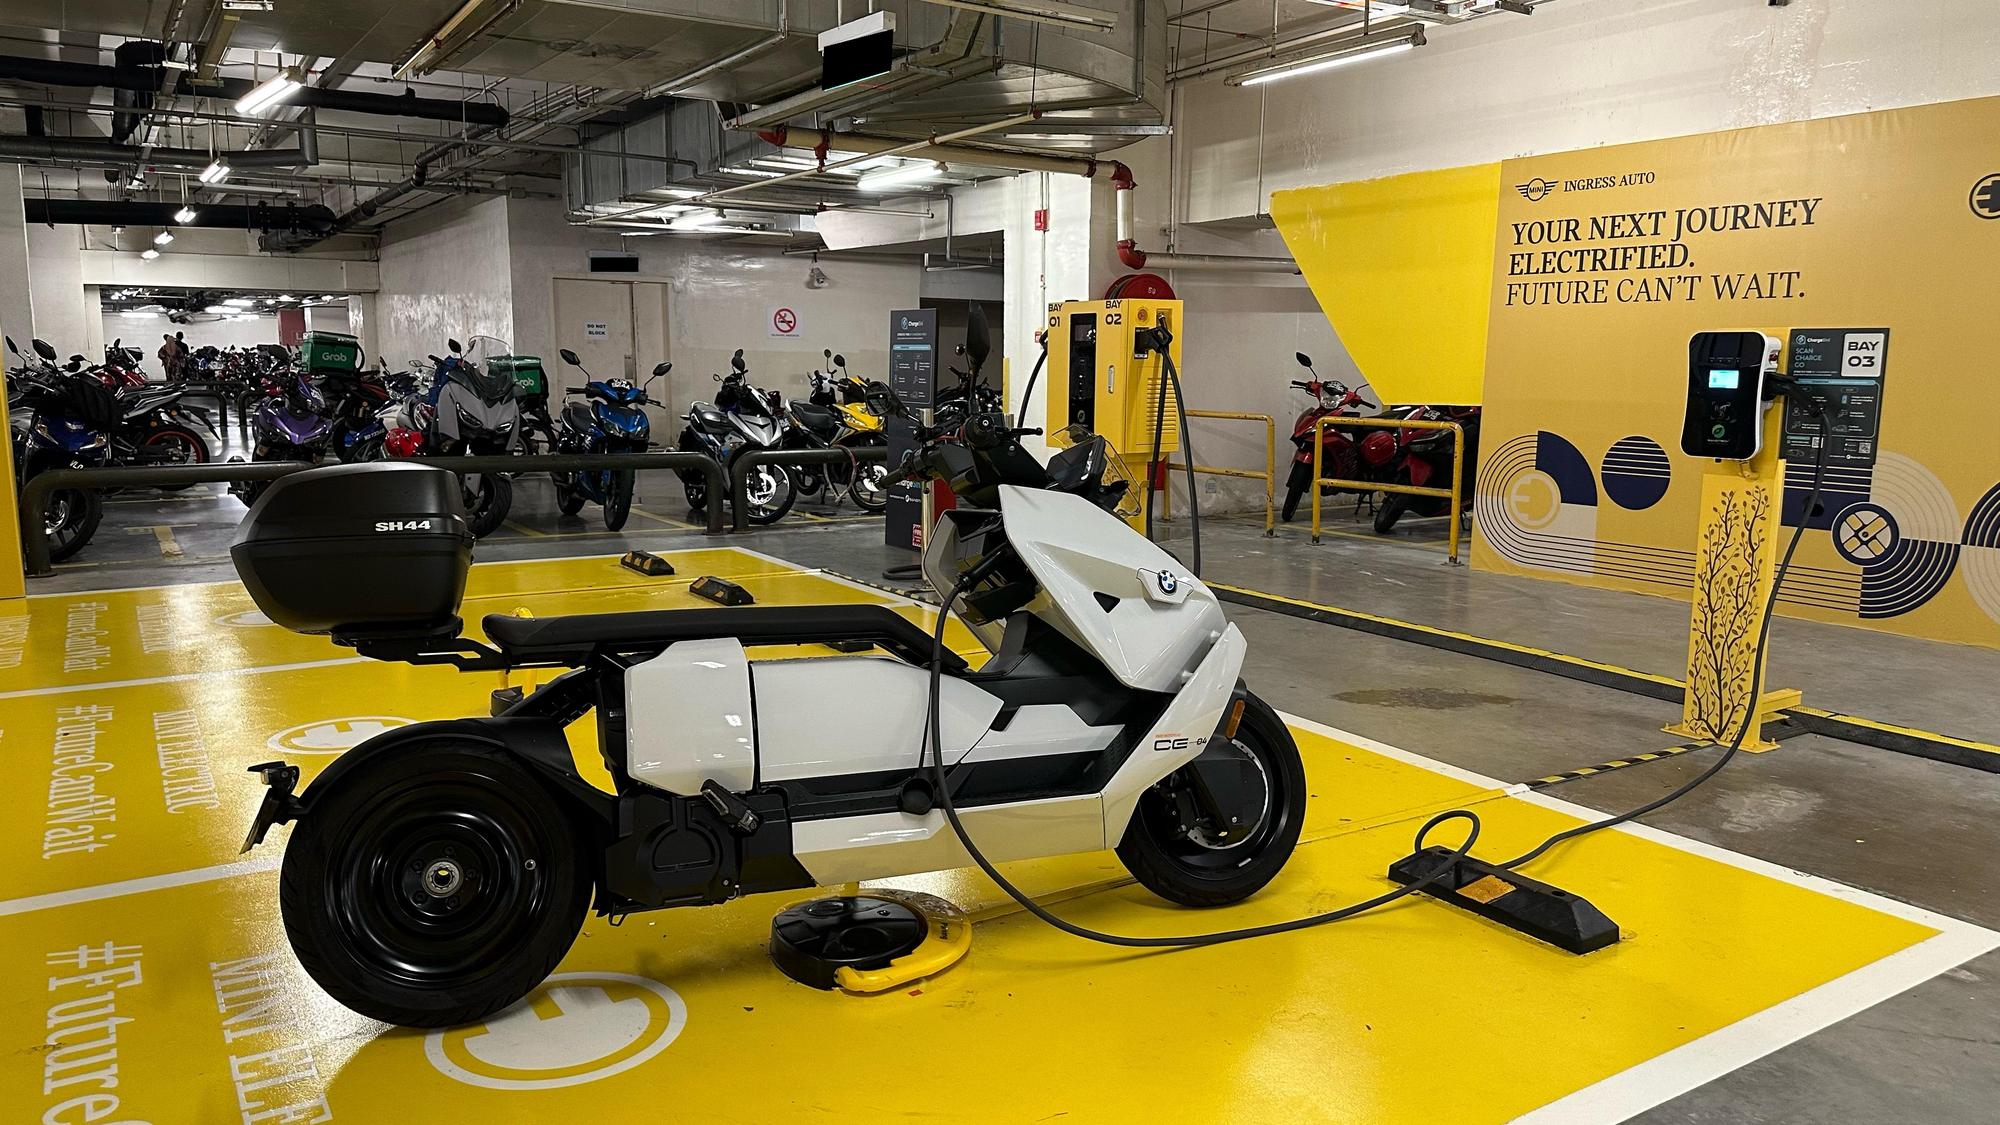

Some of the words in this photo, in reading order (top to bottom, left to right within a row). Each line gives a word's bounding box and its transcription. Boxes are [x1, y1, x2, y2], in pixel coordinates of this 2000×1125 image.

[1564, 175, 1616, 192] INGRESS
[1618, 171, 1656, 187] AUTO
[1528, 185, 1544, 194] MINI
[1511, 219, 1582, 246] YOUR
[1588, 211, 1666, 240] NEXT
[1671, 198, 1823, 242] JOURNEY
[1507, 243, 1695, 276] ELECTRIFIED.
[1505, 279, 1609, 306] FUTURE
[1616, 274, 1702, 303] CAN'T
[1710, 271, 1806, 300] WAIT.
[1048, 303, 1063, 312] BAY
[1105, 300, 1122, 309] BAY
[1049, 316, 1060, 327] 01
[1105, 313, 1122, 325] 02
[1847, 341, 1880, 351] BAY
[321, 351, 347, 362] Grab
[1847, 355, 1875, 367] 03
[375, 520, 431, 532] SH44
[153, 709, 200, 741] MINI
[1154, 737, 1189, 751] CE
[42, 704, 117, 860] #FutureCantWait
[157, 738, 221, 815] ELECTRIC
[208, 950, 298, 1045] MINI
[42, 941, 153, 1125] #Future
